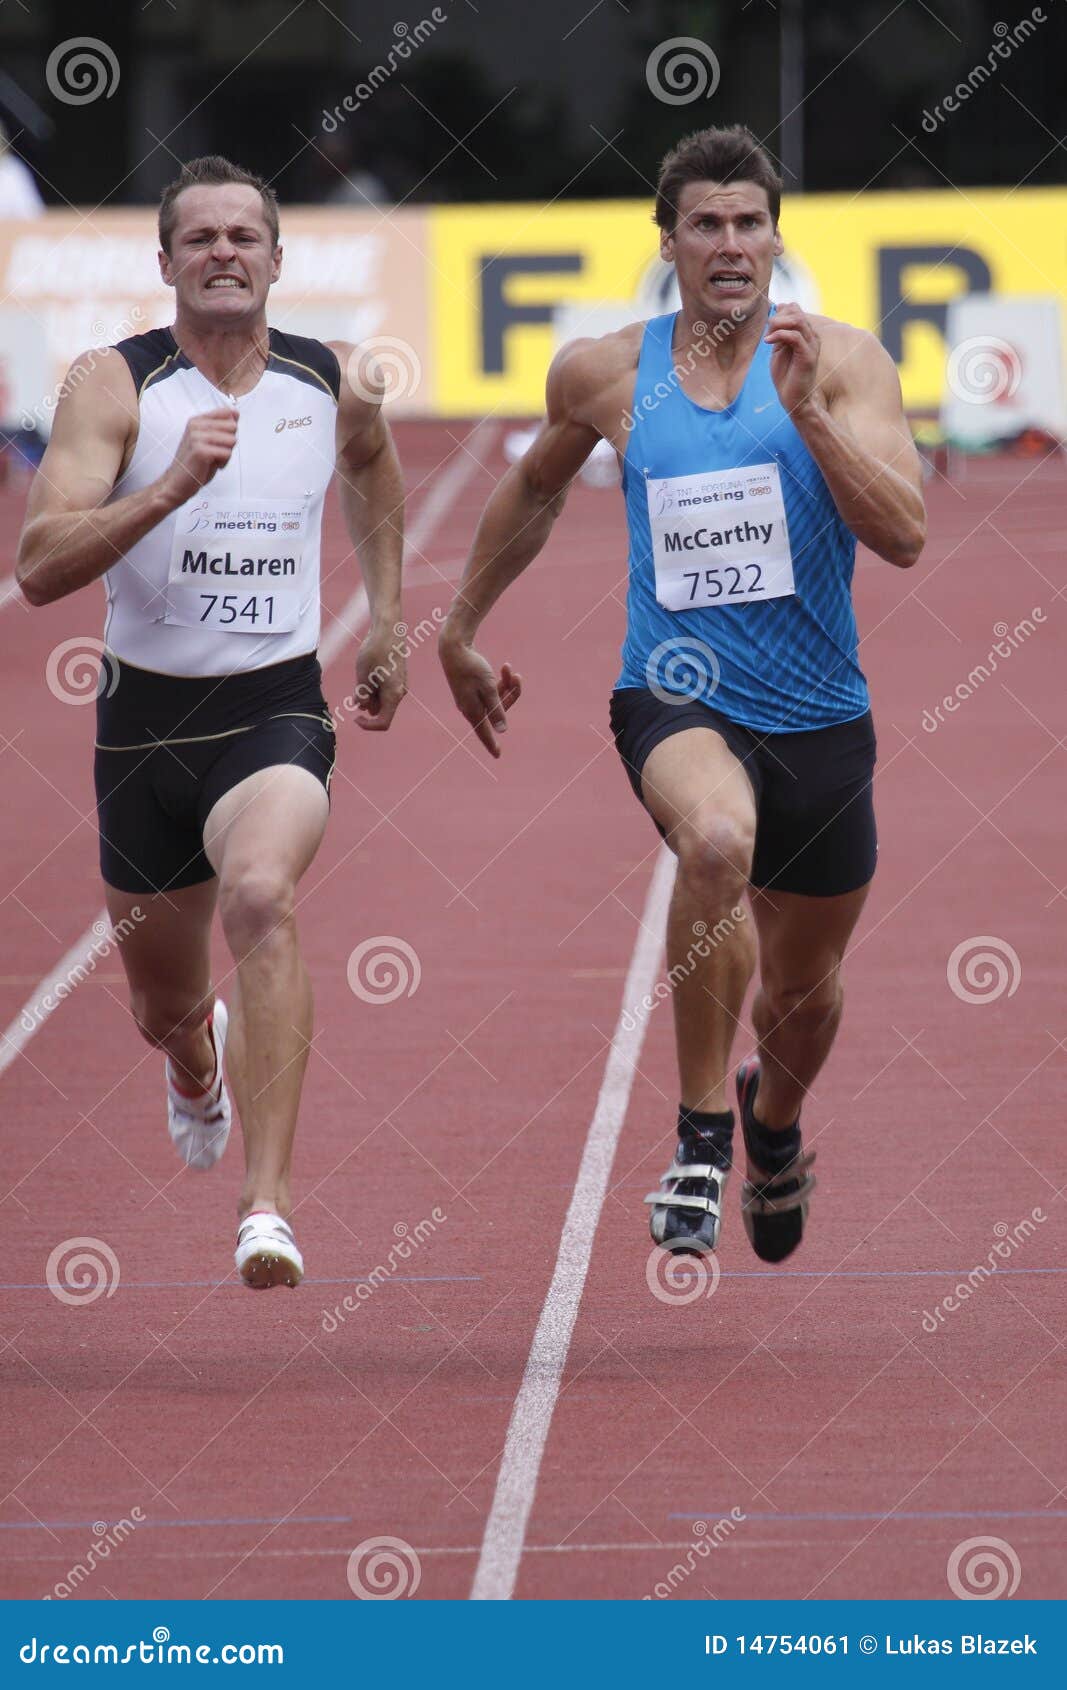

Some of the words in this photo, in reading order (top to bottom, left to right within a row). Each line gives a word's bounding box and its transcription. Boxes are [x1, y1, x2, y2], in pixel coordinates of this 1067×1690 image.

[475, 251, 584, 376] F
[287, 415, 312, 430] asics
[678, 490, 744, 507] meeting
[214, 520, 277, 532] meeting
[663, 521, 774, 553] McCarthy
[181, 549, 296, 576] McLaren
[683, 563, 765, 600] 7522
[199, 594, 276, 625] 7541
